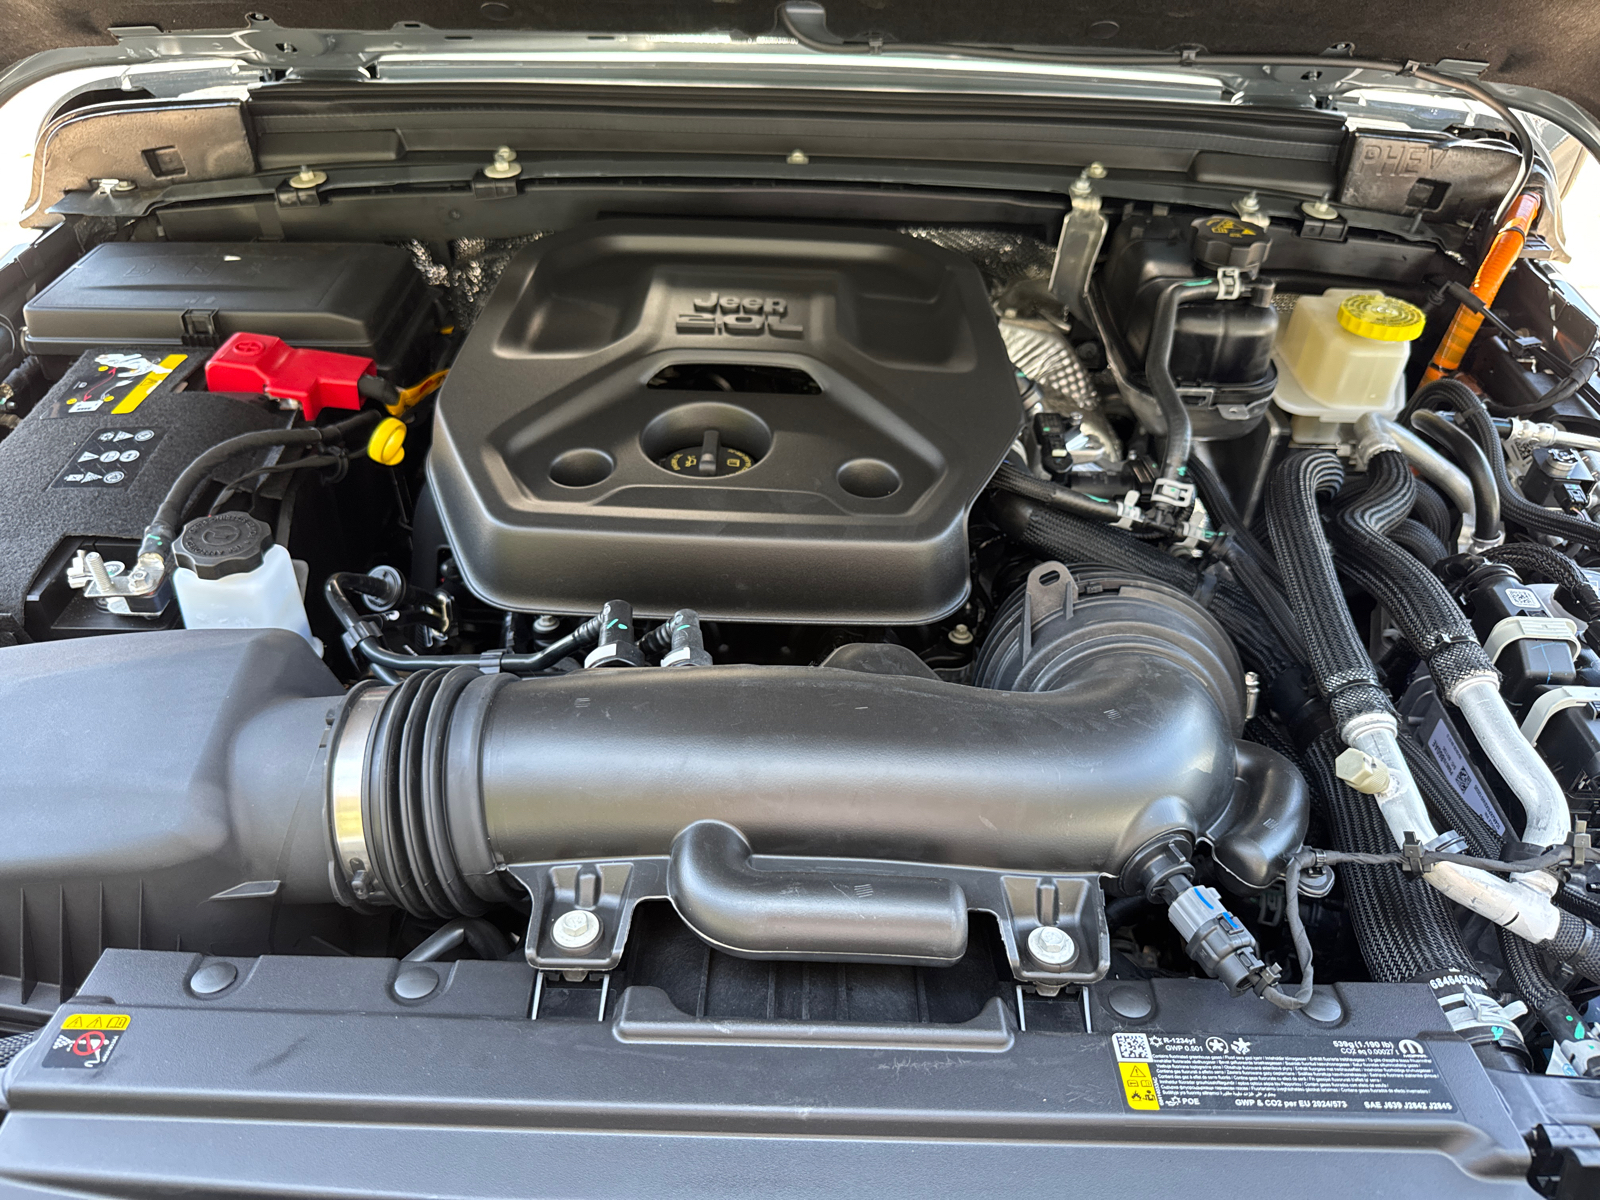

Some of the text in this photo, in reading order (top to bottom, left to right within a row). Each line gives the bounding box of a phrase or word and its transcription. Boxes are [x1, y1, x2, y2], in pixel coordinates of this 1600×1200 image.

[1354, 144, 1449, 177] PHEV
[693, 291, 788, 317] Jeep
[675, 314, 803, 338] 2.0L
[1429, 974, 1488, 990] 68464624AB
[1181, 1097, 1200, 1105] POE
[1234, 1098, 1255, 1107] GWP
[1256, 1099, 1264, 1107] &
[1264, 1099, 1282, 1107] CO2
[1283, 1100, 1297, 1109] per
[1298, 1099, 1311, 1107] EU
[1363, 1101, 1382, 1110] SAE
